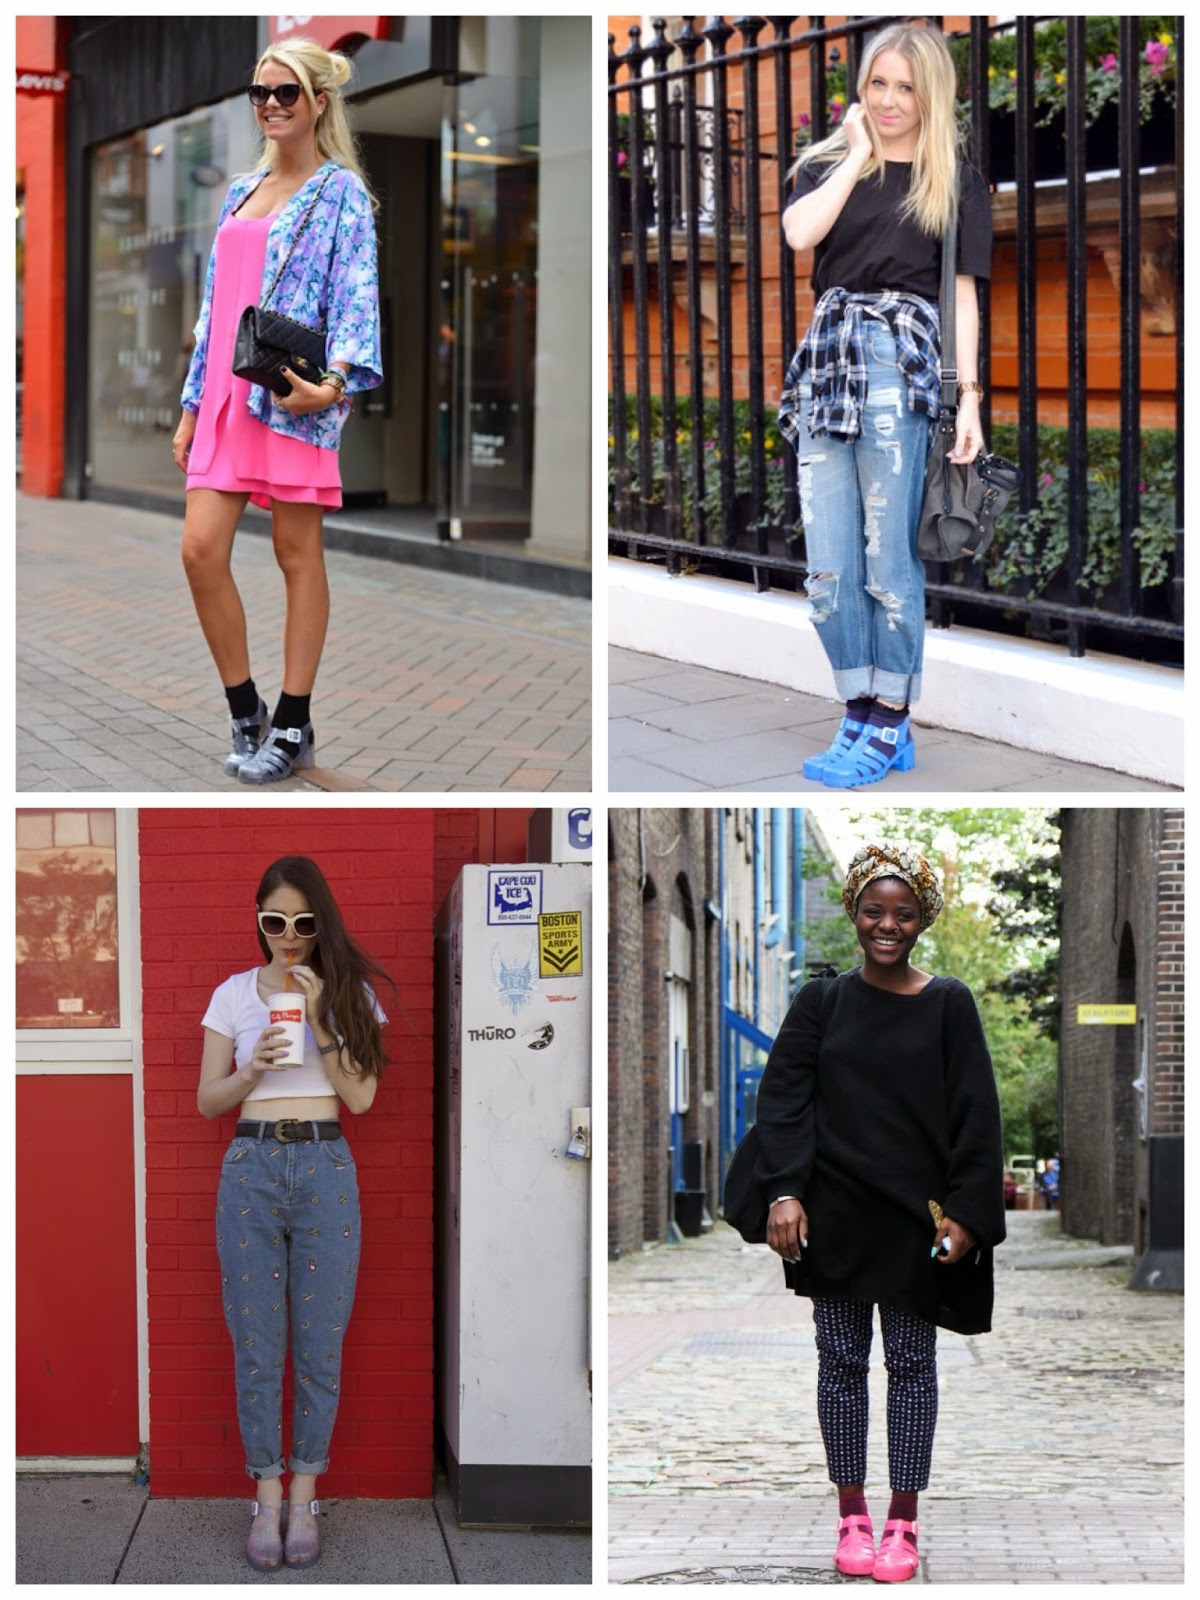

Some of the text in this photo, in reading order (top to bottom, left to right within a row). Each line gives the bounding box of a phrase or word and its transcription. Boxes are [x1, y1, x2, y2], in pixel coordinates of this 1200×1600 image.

[498, 876, 519, 886] CAPE
[506, 887, 522, 898] ICE
[541, 914, 578, 927] BOSTON
[542, 930, 578, 939] SPORTS
[547, 938, 573, 948] ARMY
